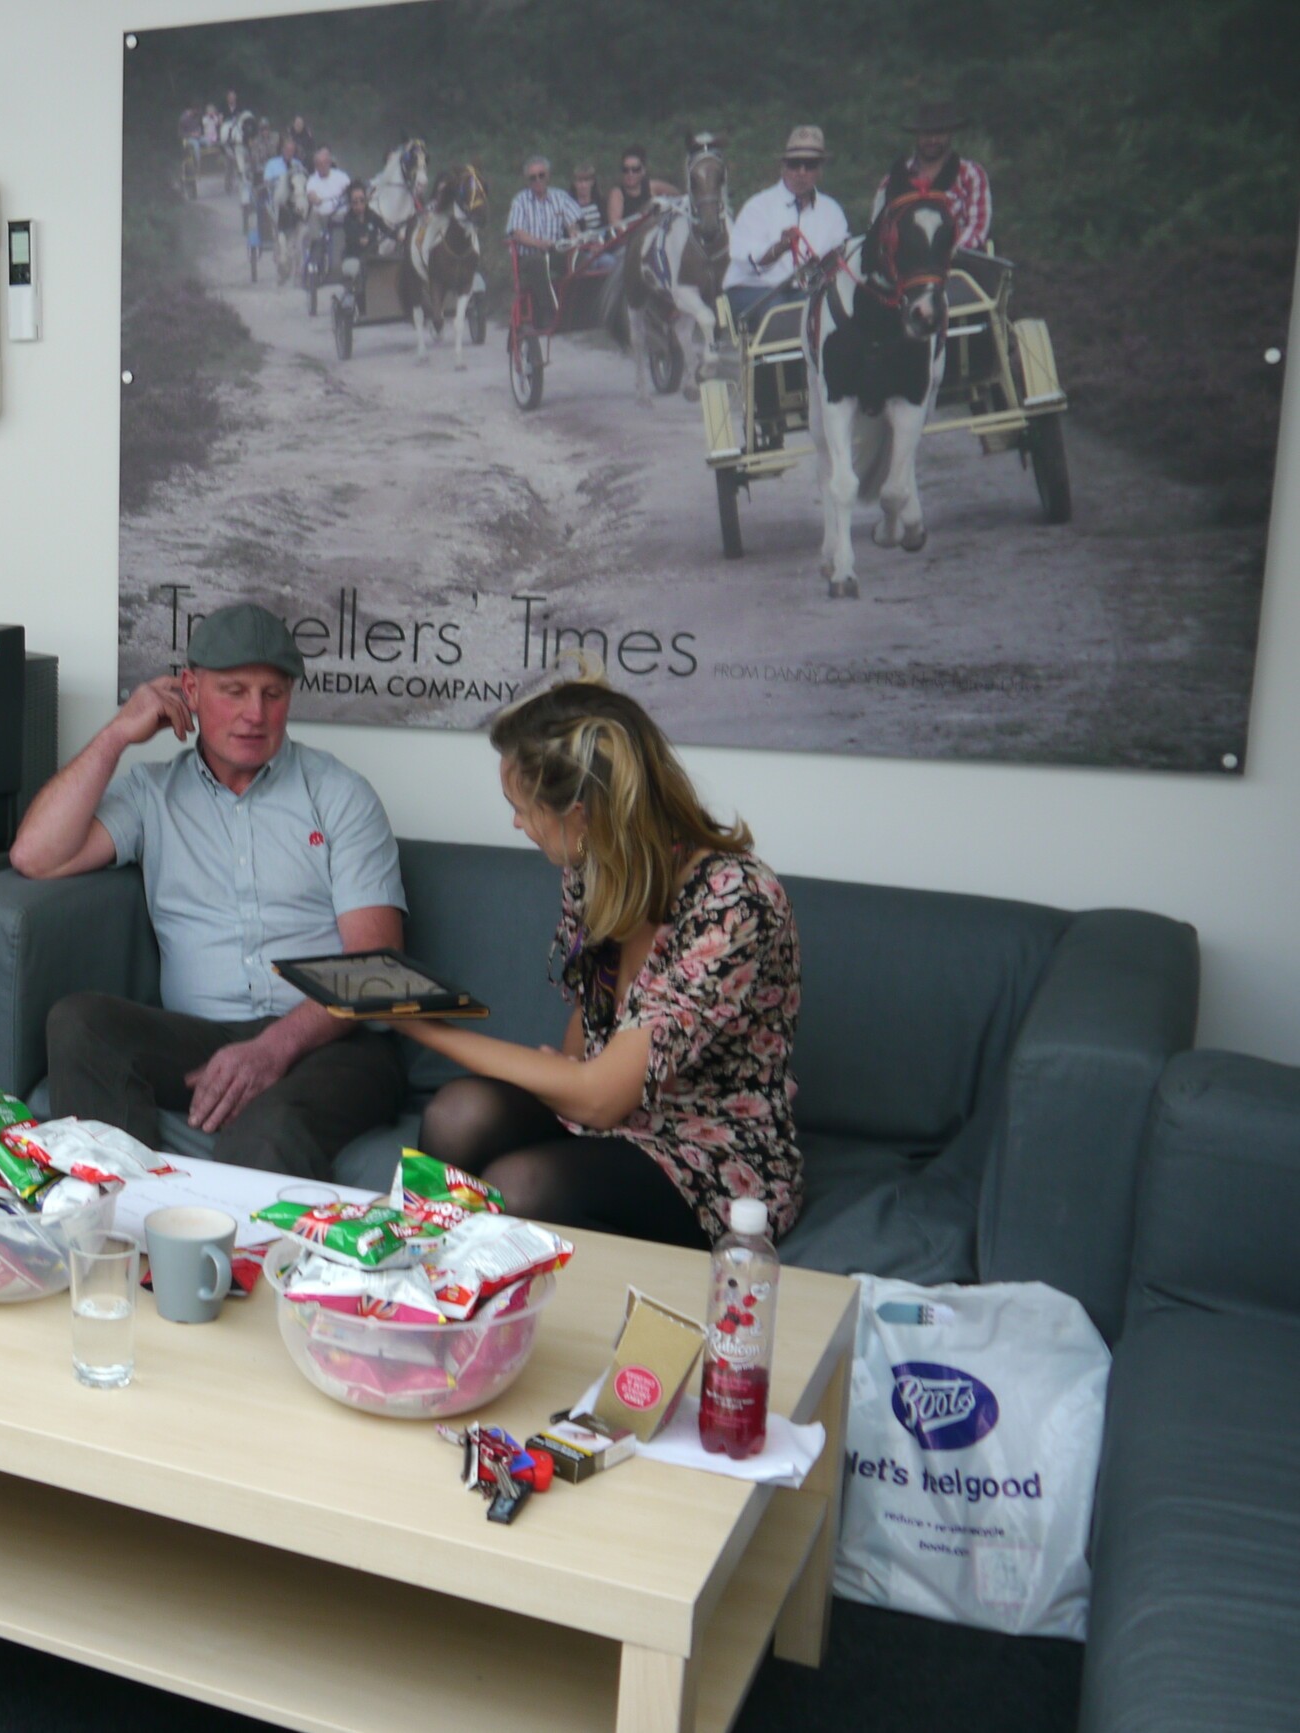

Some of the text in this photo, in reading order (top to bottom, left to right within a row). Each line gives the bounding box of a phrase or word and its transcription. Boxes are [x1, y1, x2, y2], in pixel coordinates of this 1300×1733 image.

[511, 595, 698, 678] Times
[300, 671, 520, 702] MEDIA COMPANY
[713, 662, 759, 680] FROM
[764, 664, 818, 683] DANNY
[895, 1374, 977, 1430] Boots
[850, 1450, 909, 1486] let's
[965, 1471, 1042, 1503] good
